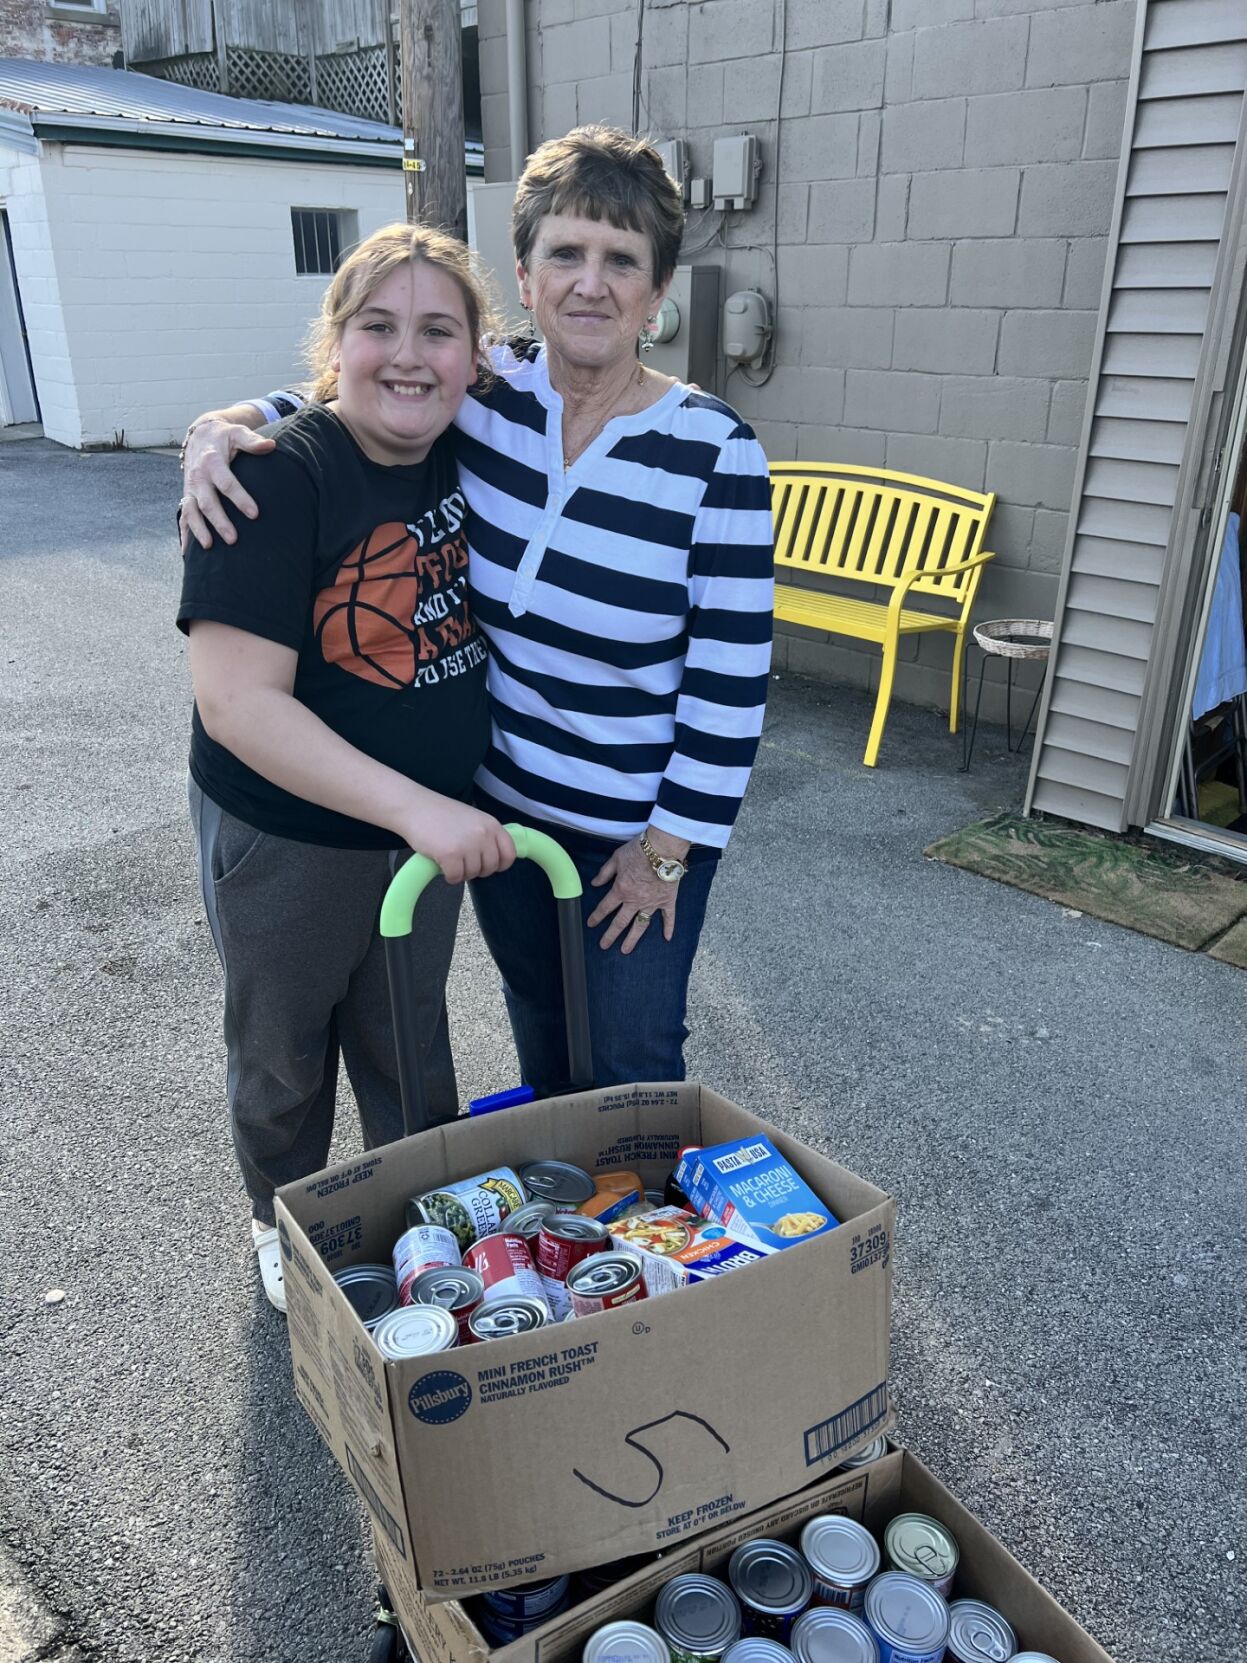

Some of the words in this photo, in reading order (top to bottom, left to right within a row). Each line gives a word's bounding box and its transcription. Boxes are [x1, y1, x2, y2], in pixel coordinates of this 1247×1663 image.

[414, 664, 440, 688] TO
[624, 1151, 657, 1162] FRENCH
[634, 1141, 680, 1151] CINNAMON
[717, 1155, 742, 1171] PASTA
[749, 1146, 768, 1160] USA
[595, 1155, 622, 1167] TOAST
[317, 1178, 350, 1198] FROZEN
[352, 1168, 373, 1184] KEEP
[729, 1165, 793, 1198] MACARONI
[743, 1195, 756, 1208] &
[753, 1178, 800, 1203] CHEESE
[472, 1198, 488, 1238] GREEN
[479, 1191, 497, 1235] COLLAR
[321, 1227, 362, 1255] 37309
[680, 1241, 721, 1260] CHICKEN
[850, 1231, 886, 1261] 37309
[478, 1365, 506, 1383] MINI
[510, 1352, 559, 1373] FRENCH
[561, 1341, 599, 1362] TOAST
[479, 1370, 547, 1395] CINNAMON
[480, 1387, 527, 1404] NATURALLY
[529, 1376, 570, 1393] FLAVORED
[410, 1381, 469, 1414] Pillsbury
[656, 1525, 682, 1540] STORE
[683, 1521, 691, 1530] AT
[708, 1511, 719, 1520] OR
[720, 1501, 746, 1515] BELOW
[668, 1509, 694, 1527] KEEP
[696, 1493, 733, 1516] FROZEN
[451, 1567, 469, 1576] 2.64
[471, 1565, 482, 1573] OZ
[508, 1553, 545, 1567] POUCHES
[434, 1579, 449, 1587] NET
